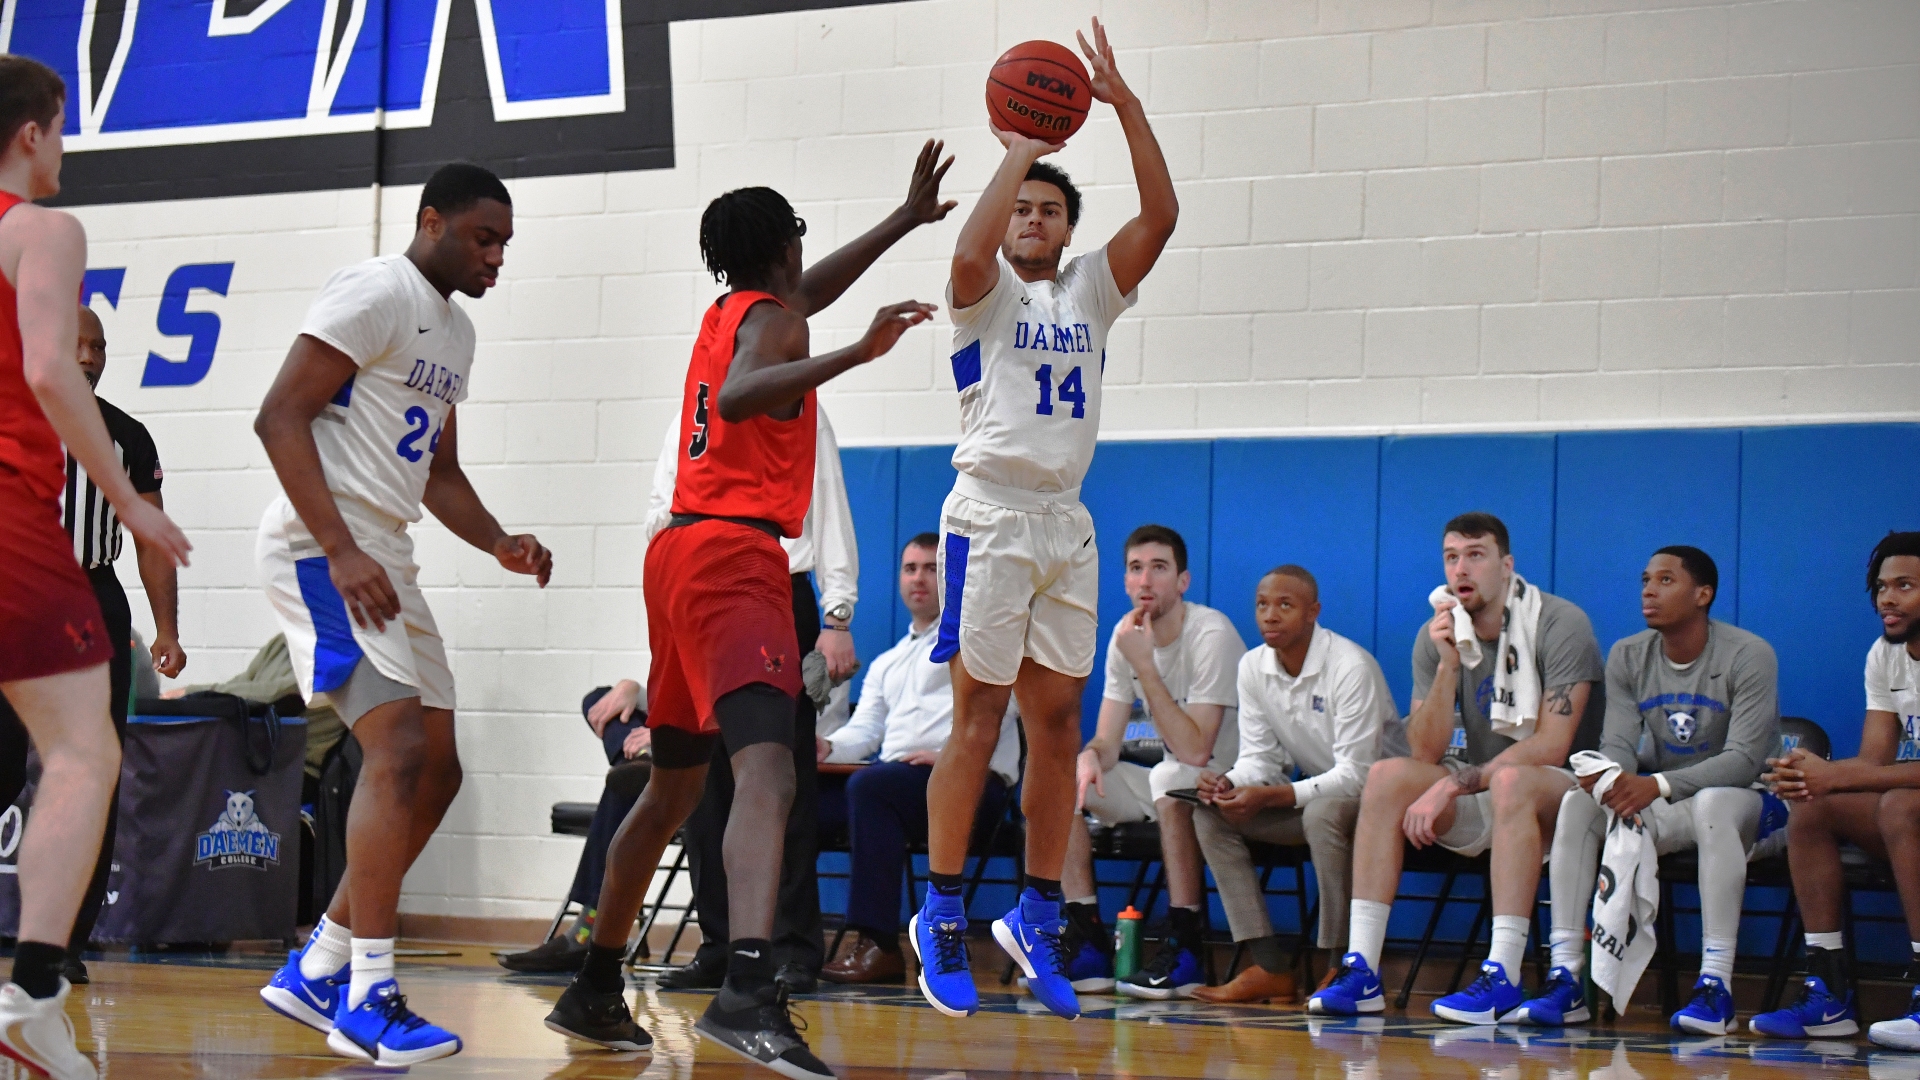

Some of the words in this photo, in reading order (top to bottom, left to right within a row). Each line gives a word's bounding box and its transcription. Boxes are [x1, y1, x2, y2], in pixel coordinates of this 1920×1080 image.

[1026, 70, 1077, 101] NCAA
[1006, 96, 1072, 131] Wilson
[1034, 363, 1086, 420] 14
[688, 381, 710, 460] 5
[197, 829, 279, 861] DAEMEN
